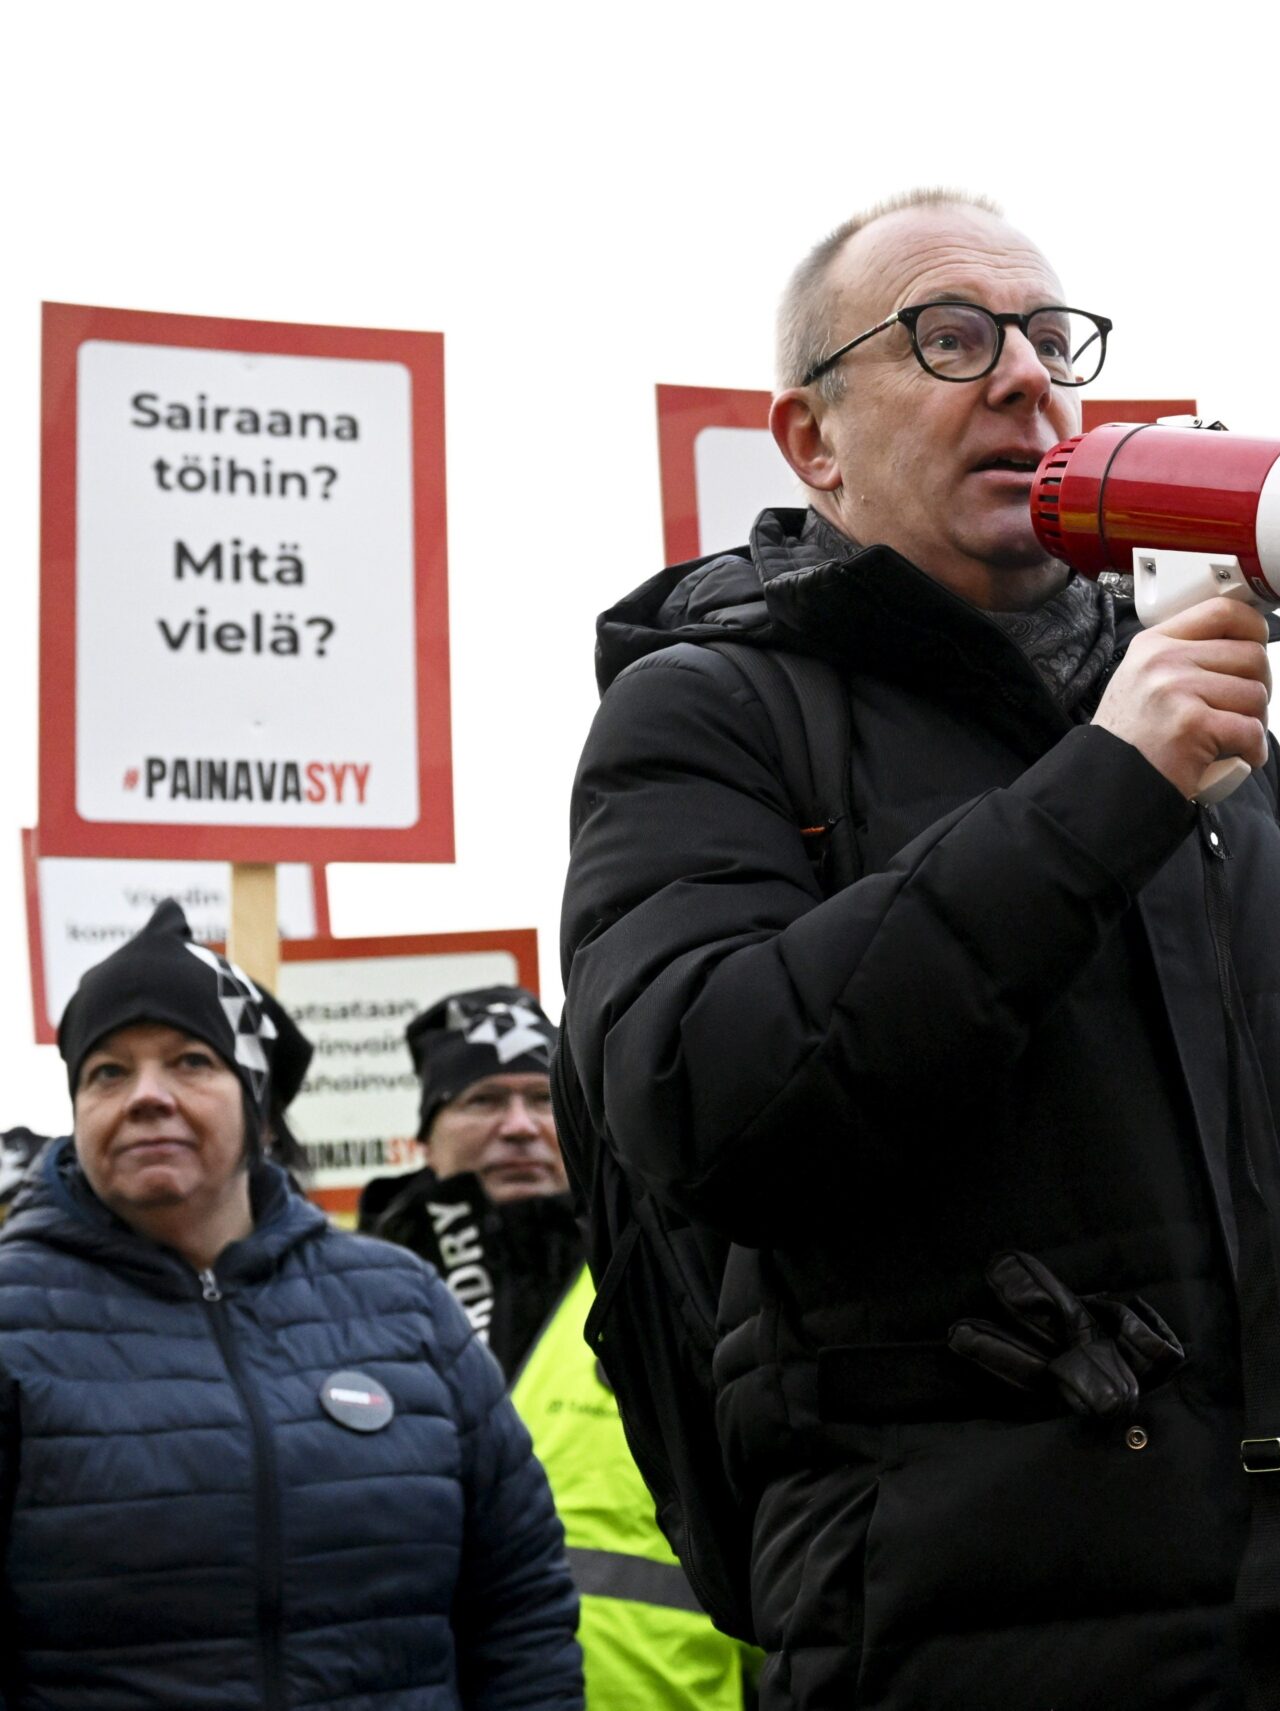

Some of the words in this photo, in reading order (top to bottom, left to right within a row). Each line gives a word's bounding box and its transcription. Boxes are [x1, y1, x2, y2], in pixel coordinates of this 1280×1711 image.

[131, 392, 360, 442] Sairaana
[152, 455, 338, 499] töihin?
[173, 538, 305, 586] Mitä
[157, 607, 336, 657] vielä?
[123, 756, 371, 804] #PAINAVASYY
